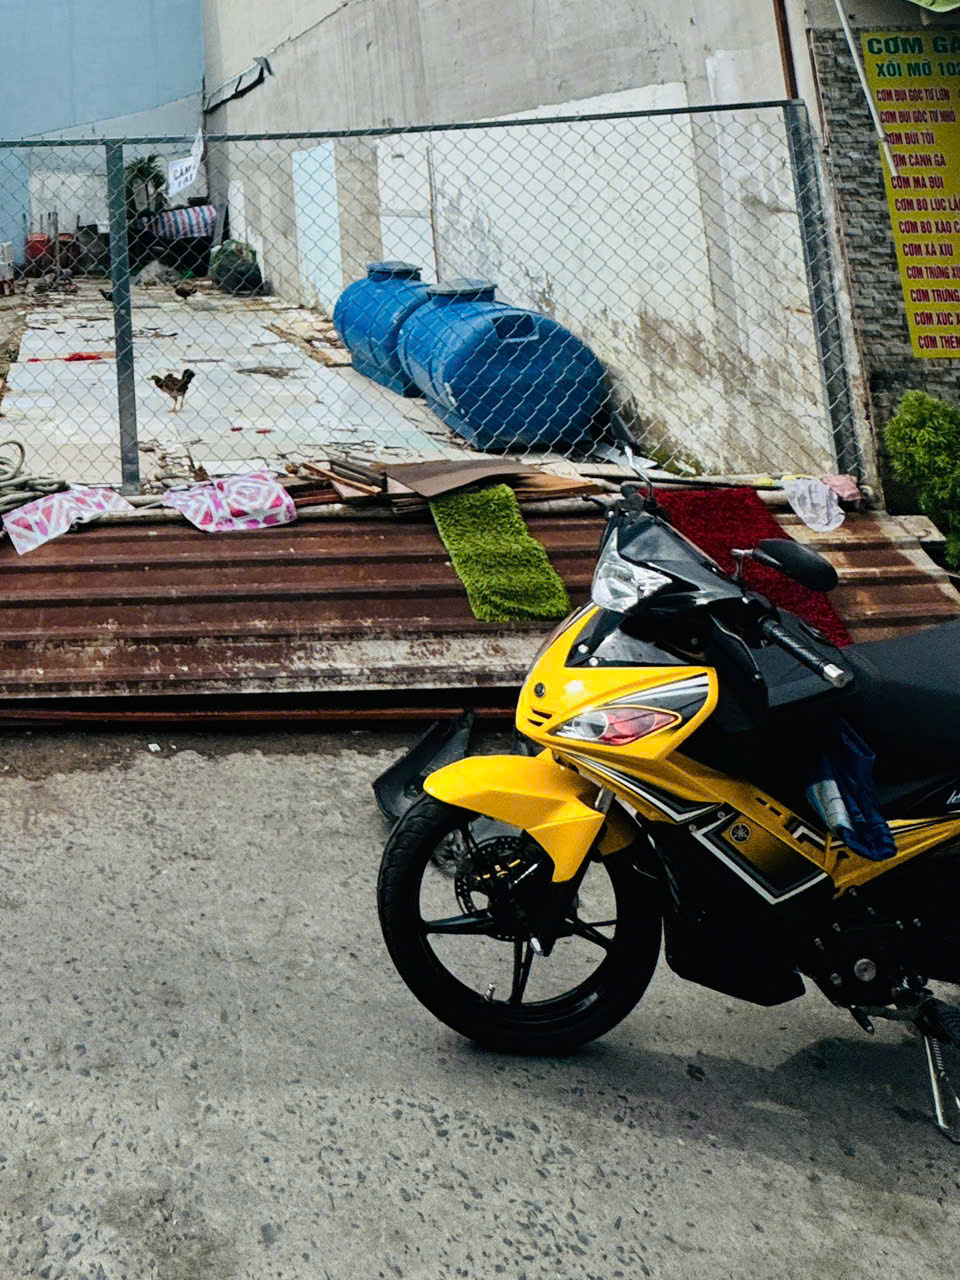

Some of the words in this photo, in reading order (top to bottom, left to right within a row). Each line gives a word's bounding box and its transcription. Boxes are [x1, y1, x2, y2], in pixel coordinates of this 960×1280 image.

[867, 35, 924, 54] CƠM
[876, 58, 903, 77] XỐI
[906, 59, 933, 77] MỠ
[876, 88, 893, 101] CƠM
[880, 110, 897, 123] CƠM
[892, 152, 907, 166] ƠM
[891, 175, 911, 189] CƠM
[895, 197, 914, 211] CƠM
[899, 220, 919, 233] CƠM
[903, 243, 923, 256] CƠM
[906, 265, 924, 278] CƠM
[910, 287, 930, 302] CƠM
[914, 311, 934, 325] CƠM
[918, 334, 938, 349] CƠM
